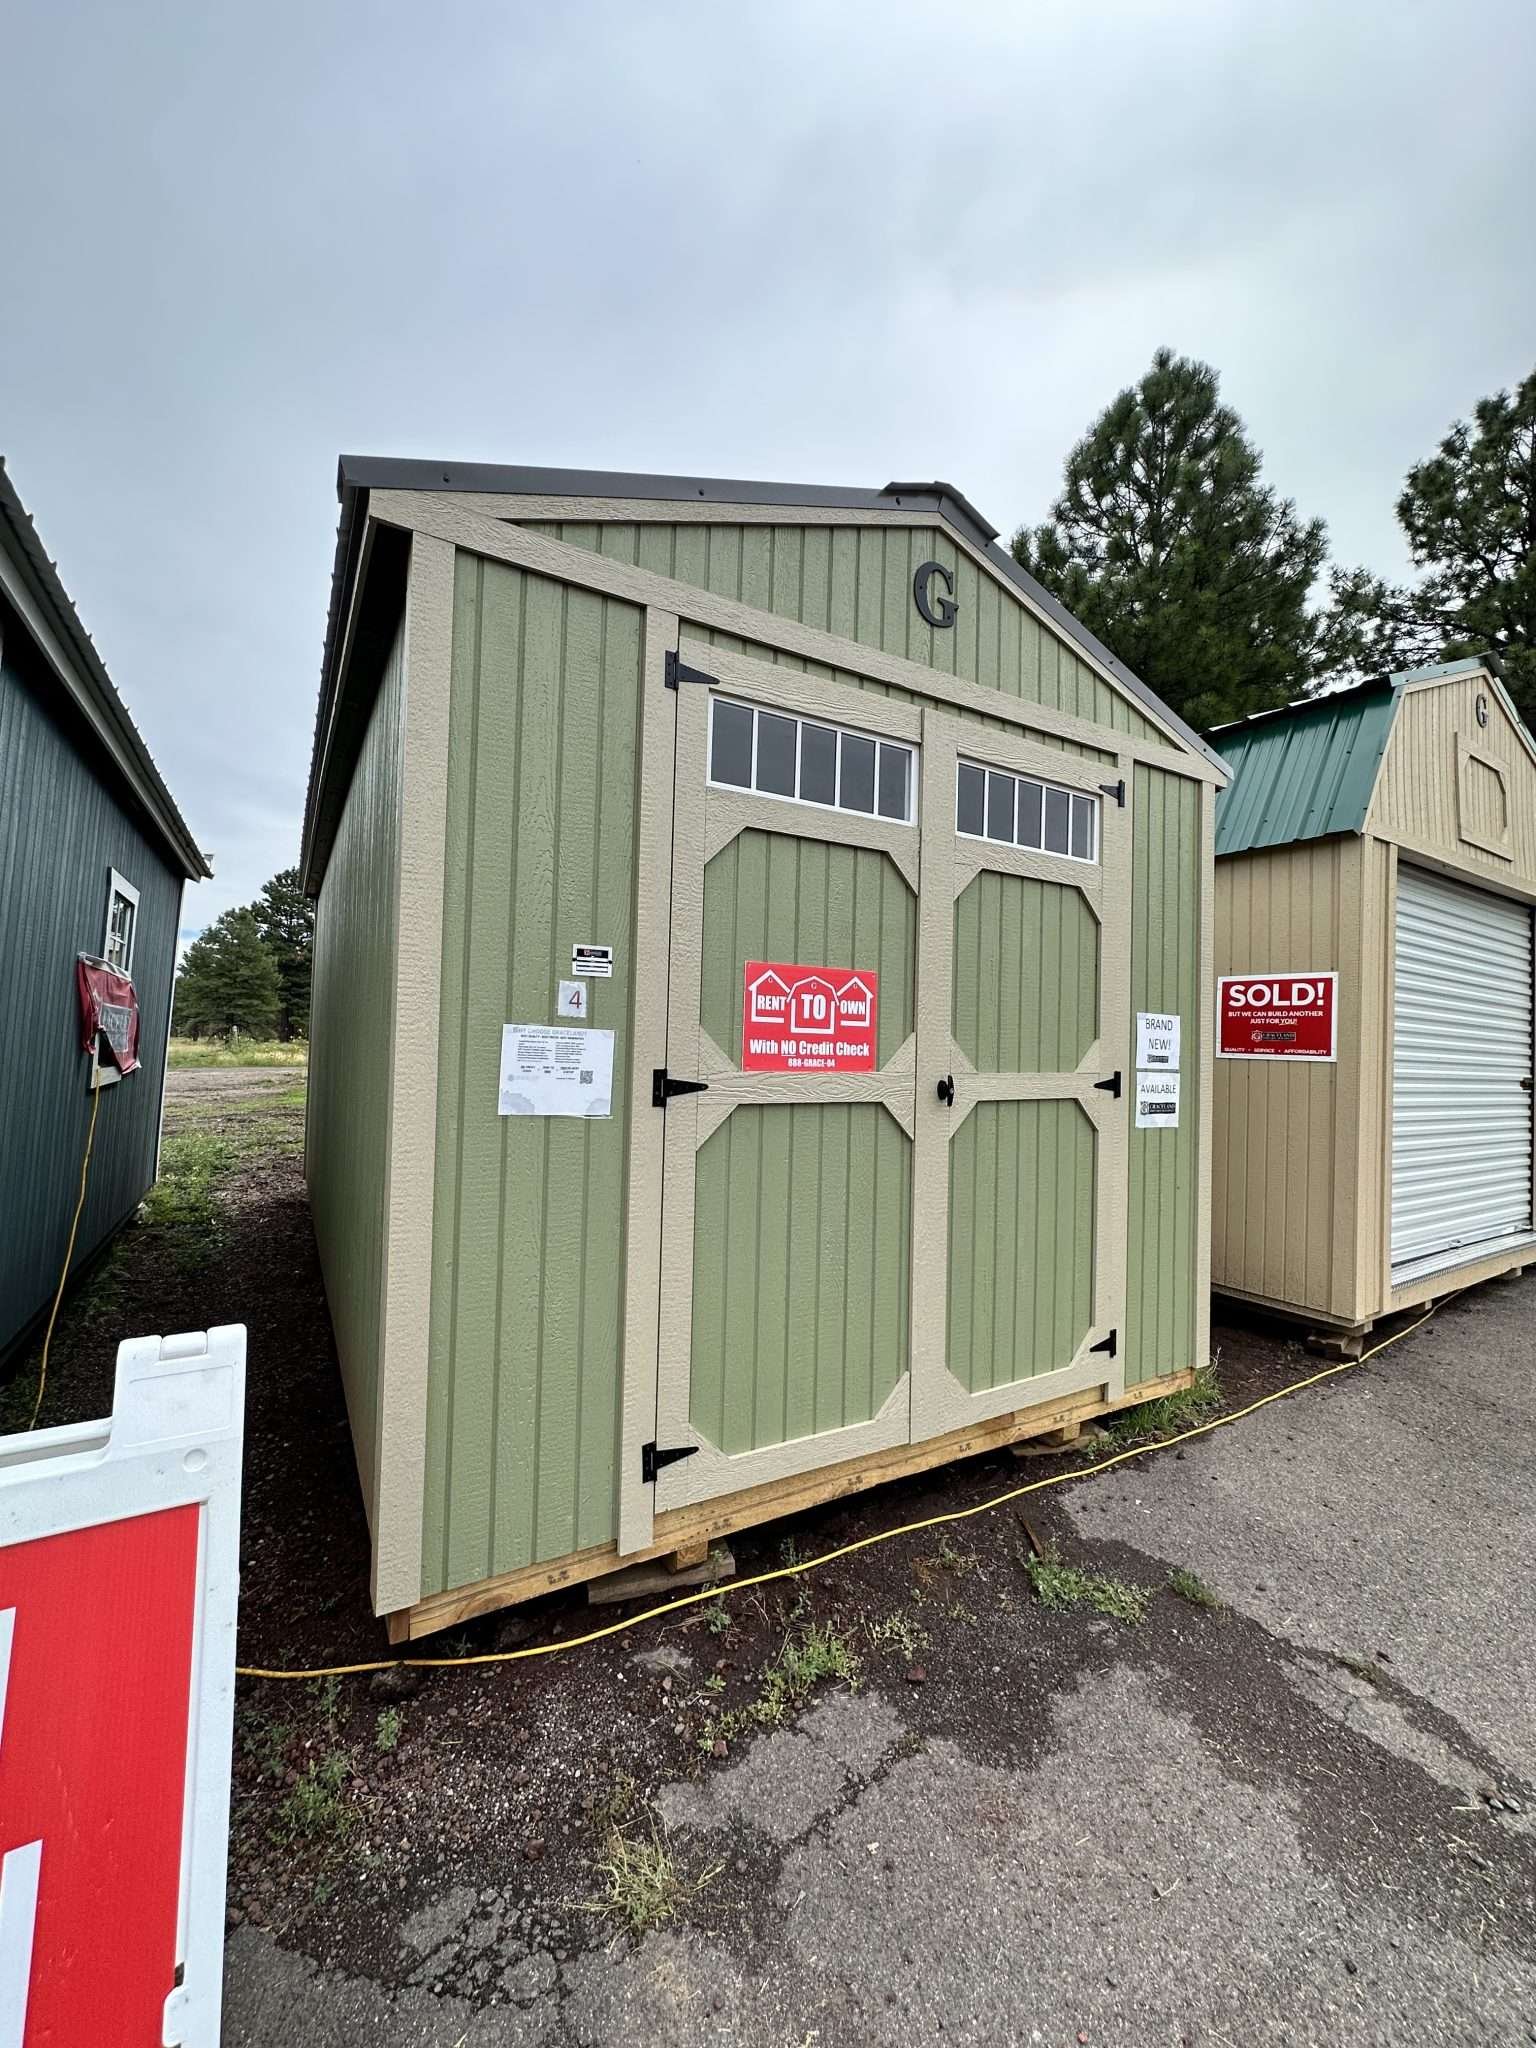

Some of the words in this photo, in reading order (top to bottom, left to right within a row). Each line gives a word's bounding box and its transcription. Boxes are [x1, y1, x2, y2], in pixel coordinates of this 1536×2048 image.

[914, 561, 959, 628] G
[569, 990, 582, 1009] 4
[1229, 982, 1325, 1007] SOLD!
[757, 995, 787, 1011] RENT
[801, 993, 827, 1020] TO
[840, 1000, 866, 1016] OWN
[1145, 1018, 1173, 1031] BRAND
[750, 1039, 778, 1054] With
[781, 1040, 797, 1055] NO
[799, 1040, 834, 1055] Credit
[836, 1041, 870, 1056] Check
[1148, 1038, 1171, 1050] NEW!
[1140, 1084, 1176, 1094] AVAILABLE
